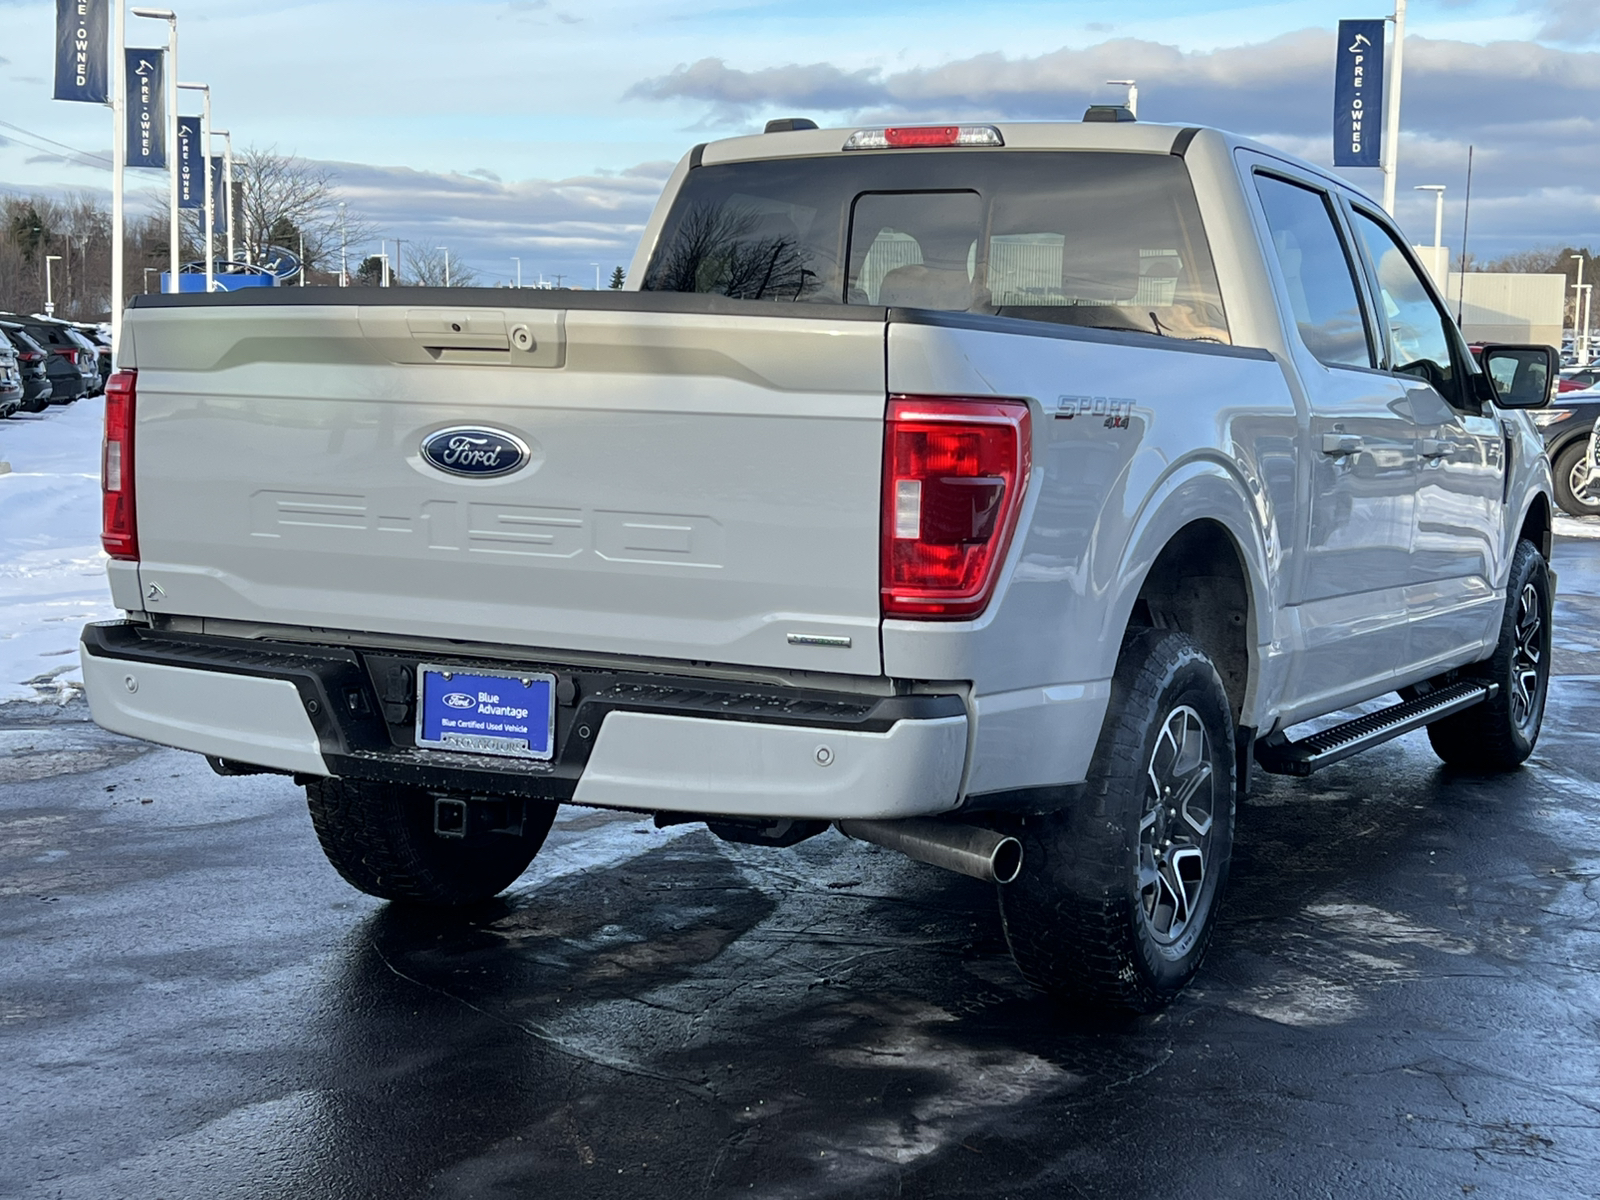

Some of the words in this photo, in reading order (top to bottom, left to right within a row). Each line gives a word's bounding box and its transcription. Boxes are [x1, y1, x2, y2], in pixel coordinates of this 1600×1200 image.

[75, 0, 88, 86] E-OWNED
[140, 77, 151, 156] PRE-OWNED
[1351, 55, 1364, 153] PRE-OWNED
[1054, 395, 1137, 420] SPORT
[443, 436, 502, 467] Ford
[448, 694, 470, 707] Ford
[478, 692, 500, 704] Blue
[477, 703, 529, 719] Advantage
[441, 718, 457, 727] Blue
[457, 719, 485, 730] Certified
[486, 722, 503, 731] Used
[504, 724, 528, 733] Vehicle
